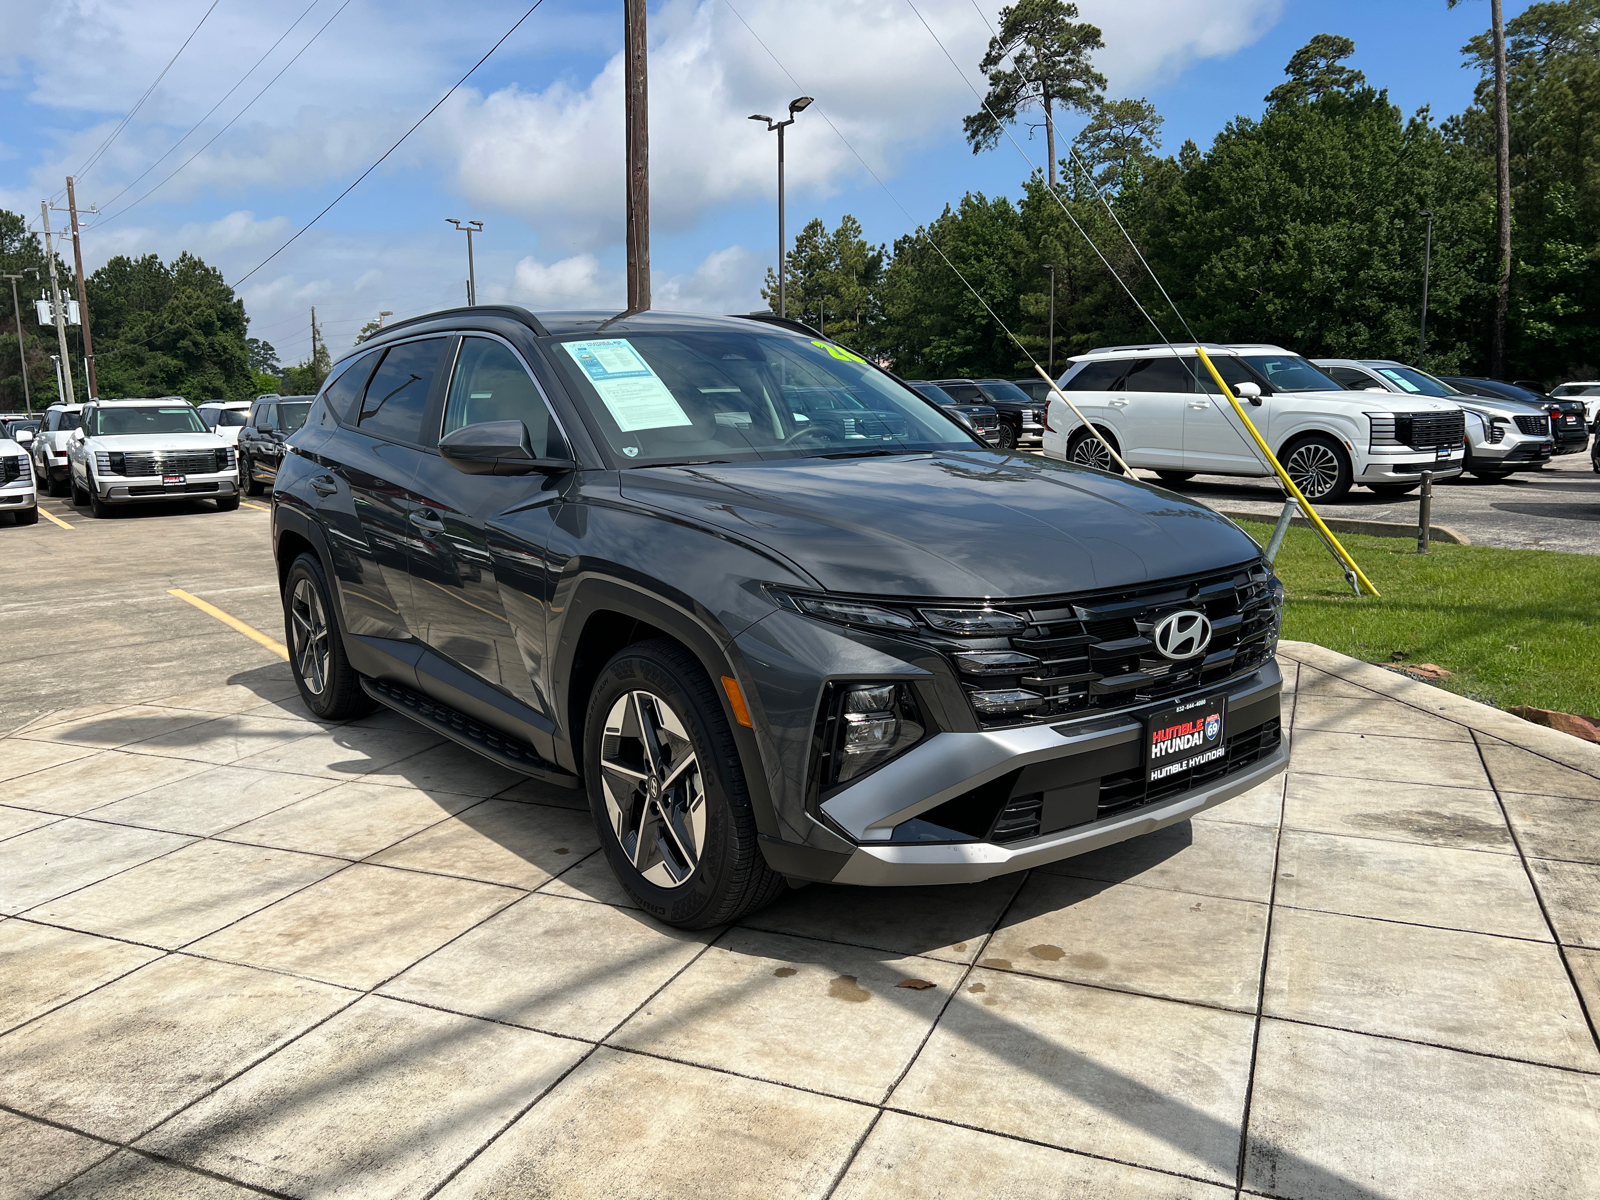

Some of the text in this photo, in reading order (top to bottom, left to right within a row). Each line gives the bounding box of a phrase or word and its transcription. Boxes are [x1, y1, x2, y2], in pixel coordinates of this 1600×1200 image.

[1151, 730, 1204, 759] HYUNDAI
[1152, 718, 1204, 743] HUMBLE
[1207, 723, 1218, 736] 69
[684, 709, 714, 787] KUMHO
[1151, 747, 1225, 781] HUMBLE HYUNDAI
[623, 883, 666, 915] CRUGEN
